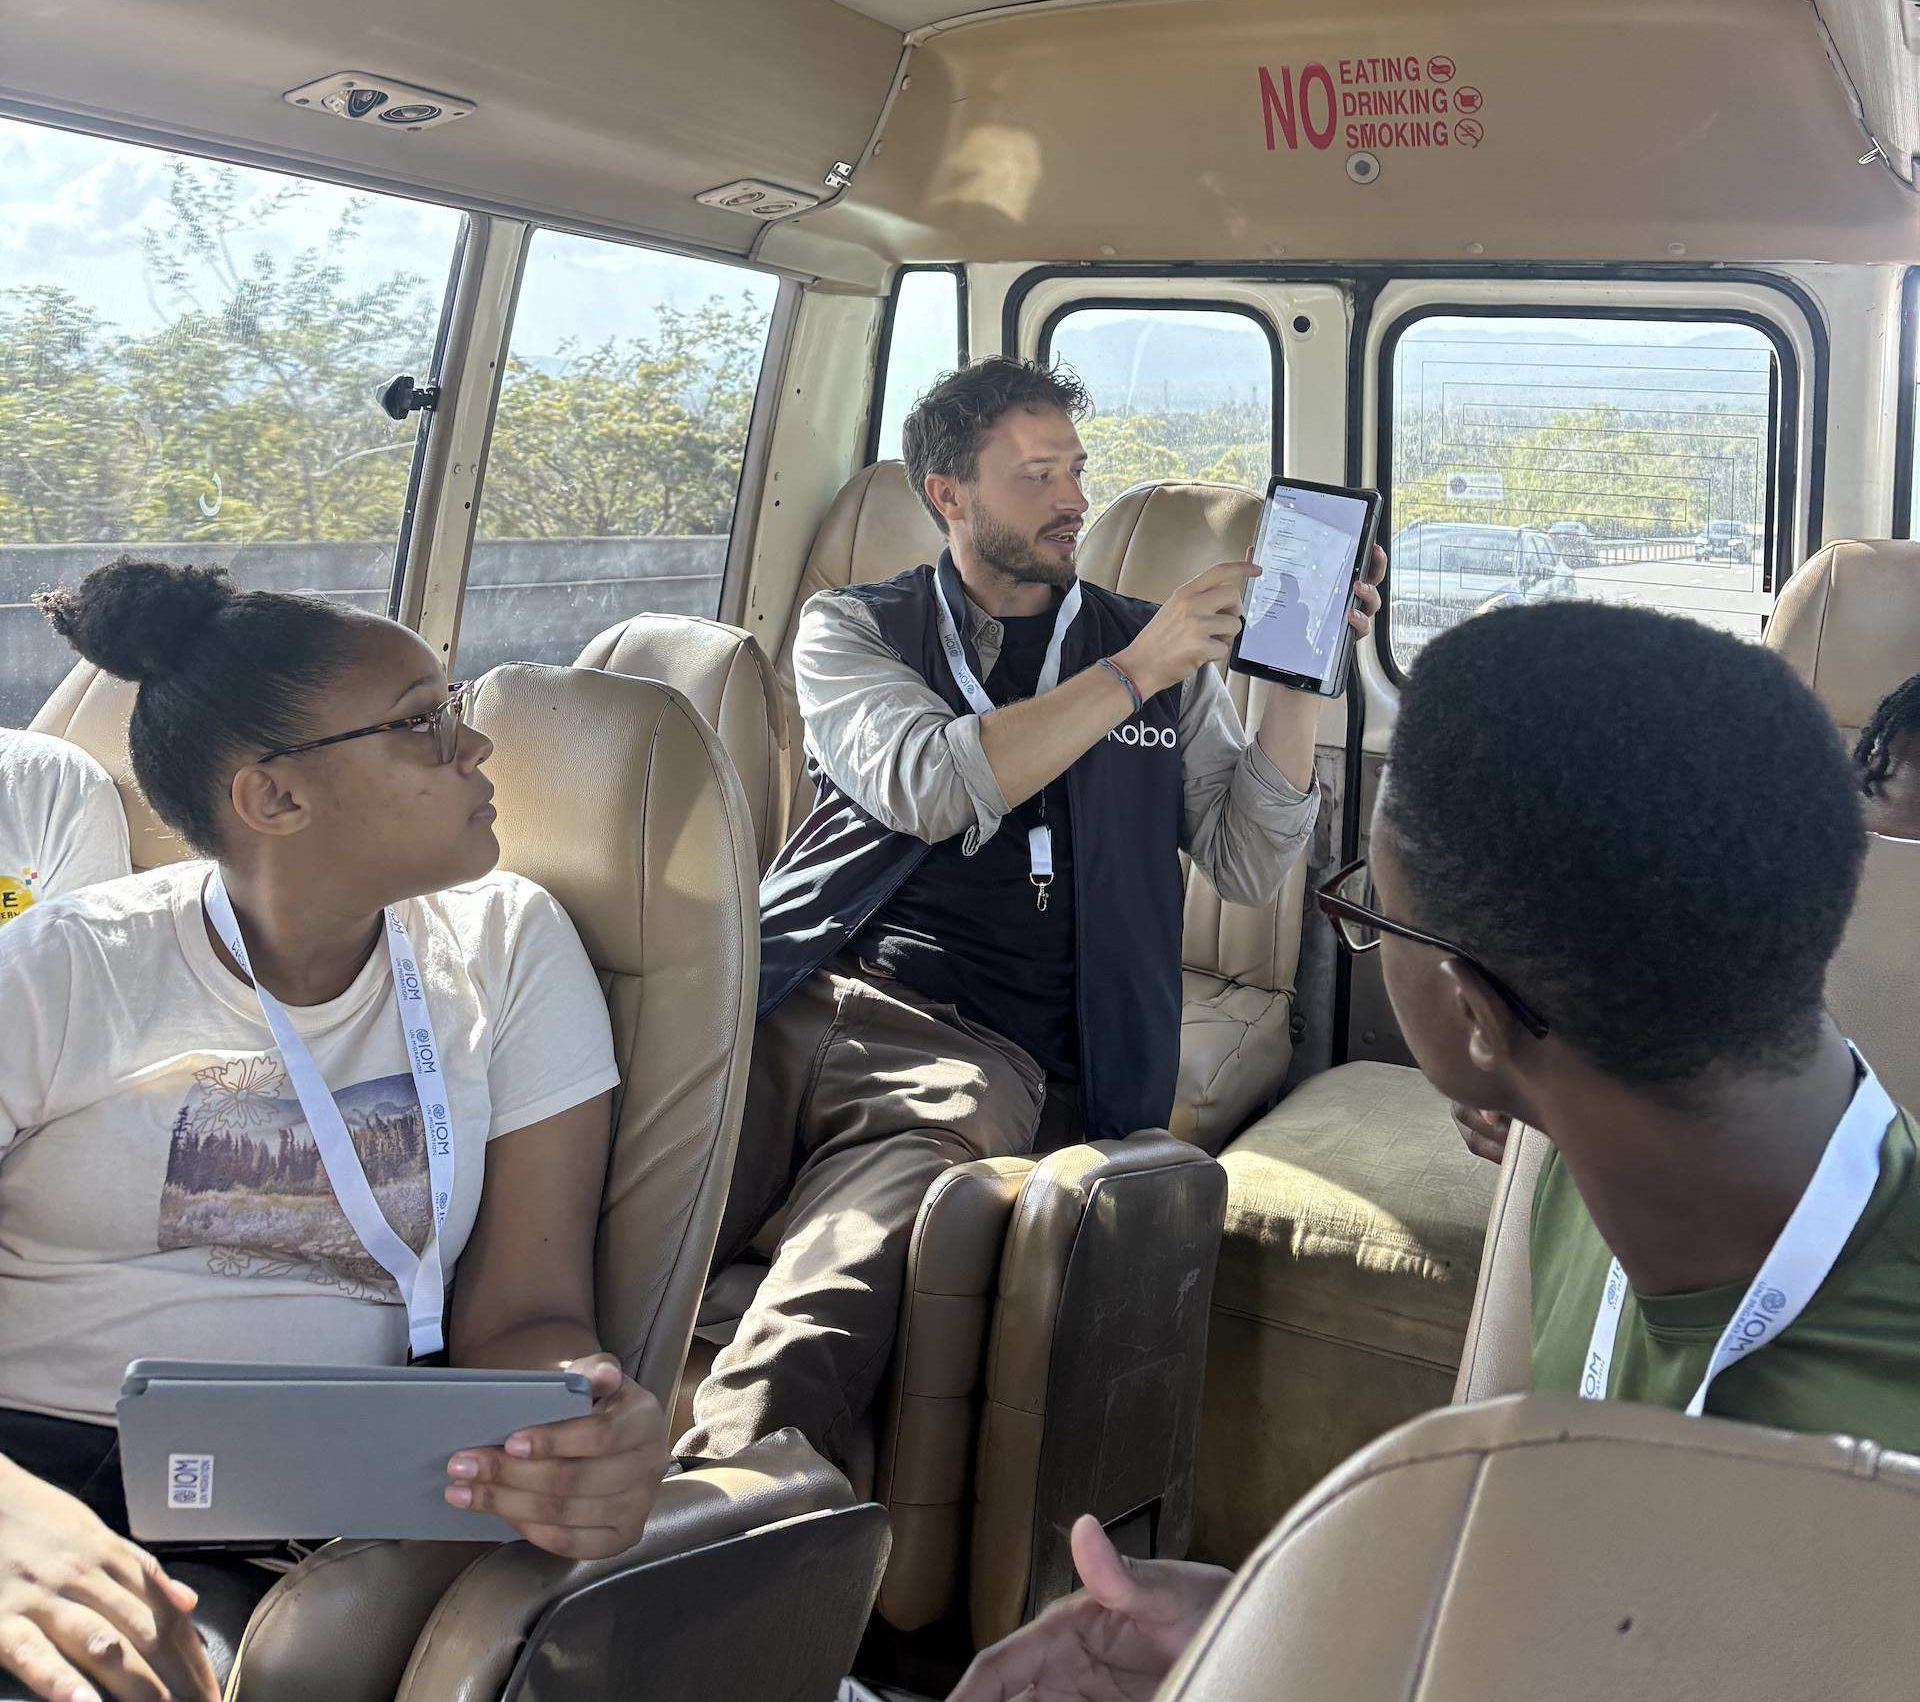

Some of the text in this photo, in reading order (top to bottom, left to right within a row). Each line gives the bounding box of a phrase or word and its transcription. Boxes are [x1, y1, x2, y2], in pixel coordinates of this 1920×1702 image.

[1339, 56, 1421, 85] EATING
[1258, 62, 1338, 151] NO
[1342, 88, 1449, 117] DRINKING
[1345, 120, 1449, 149] SMOKING
[944, 633, 956, 652] IOM
[957, 669, 971, 688] IOM
[405, 973, 422, 1001] IOM
[418, 1044, 436, 1073] IOM
[435, 1122, 450, 1155] IOM
[1729, 1312, 1773, 1351] IOM
[1584, 1351, 1602, 1397] OM
[173, 1459, 199, 1488] IOM
